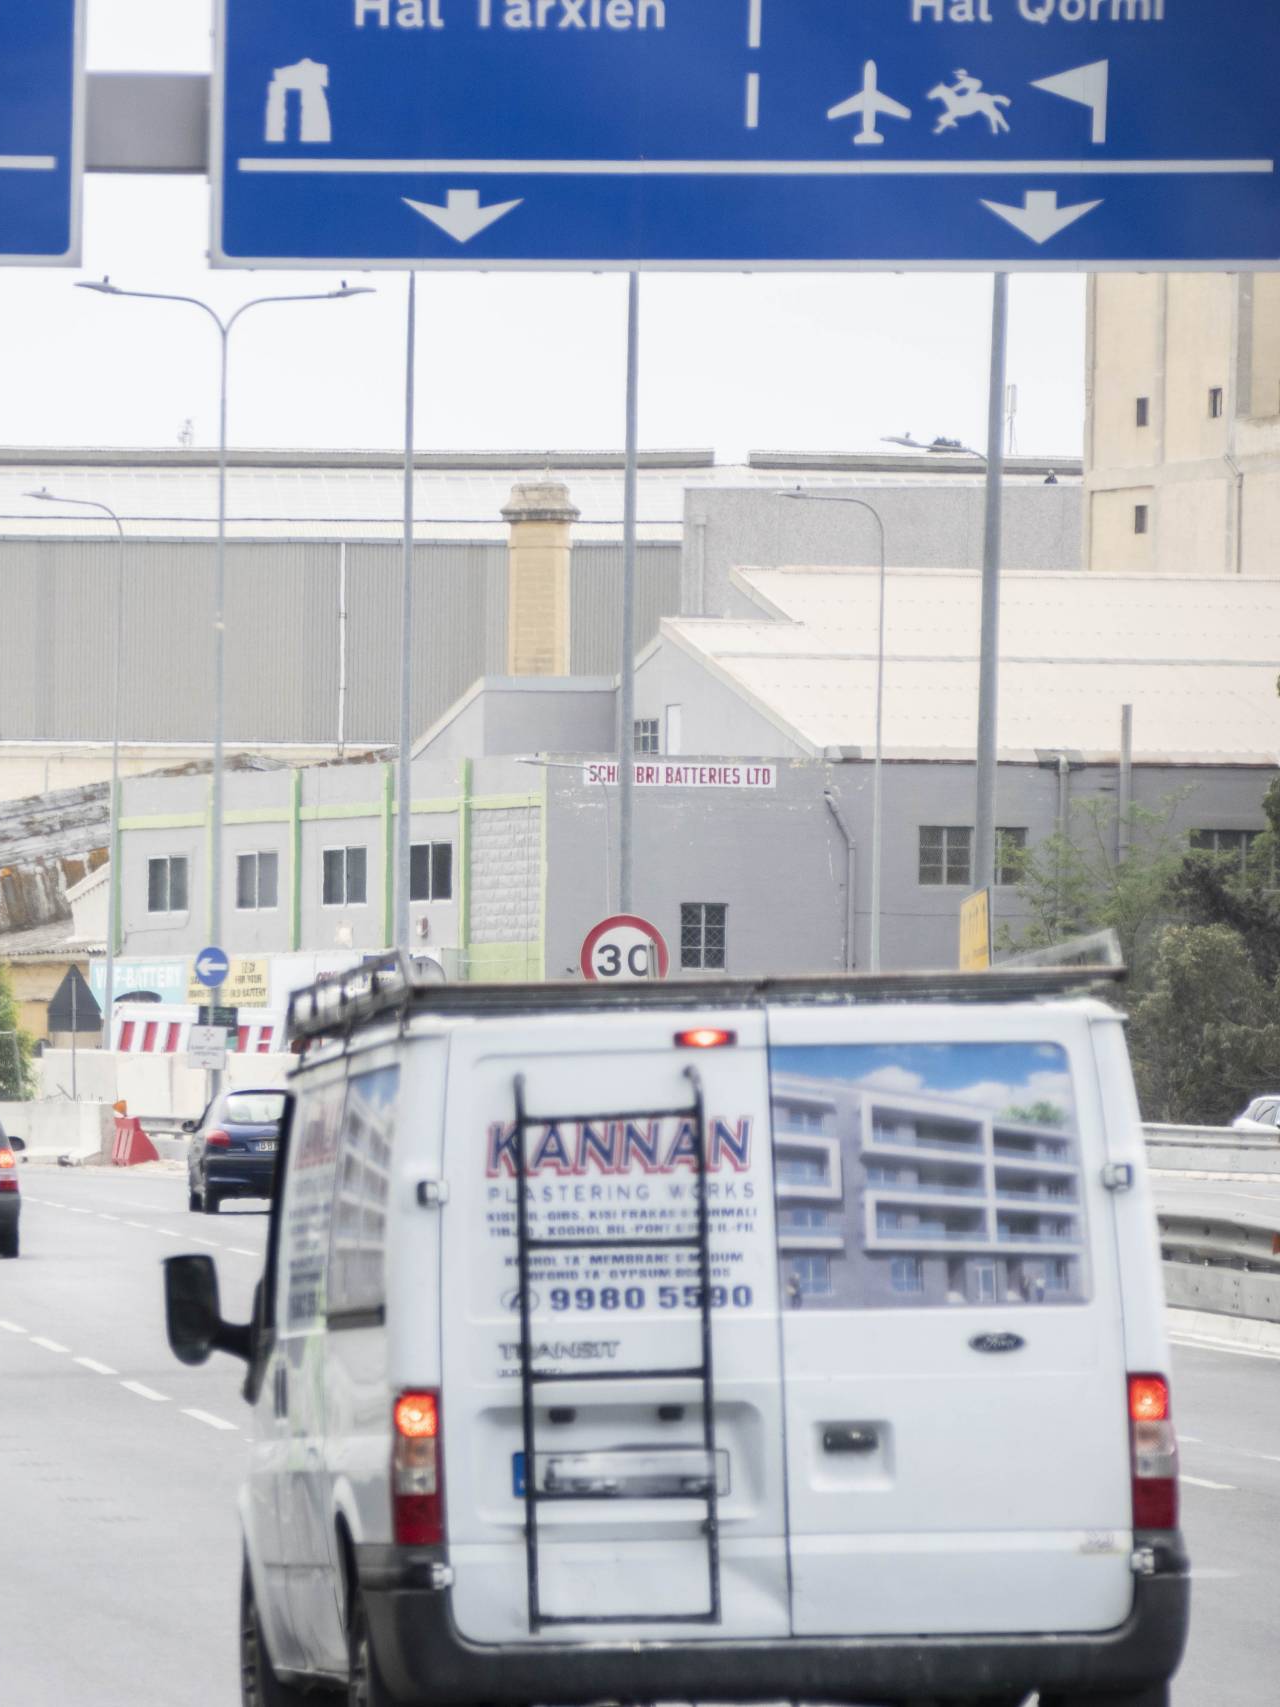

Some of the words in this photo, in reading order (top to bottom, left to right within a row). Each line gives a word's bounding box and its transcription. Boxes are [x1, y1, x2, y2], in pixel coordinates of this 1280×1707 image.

[589, 765, 660, 784] SCHBRI
[665, 767, 741, 785] BATTERIES
[746, 768, 771, 785] LTD
[597, 943, 649, 977] 30
[485, 1116, 753, 1178] KANNAN
[550, 1286, 646, 1311] 9980
[657, 1284, 754, 1309] 5590
